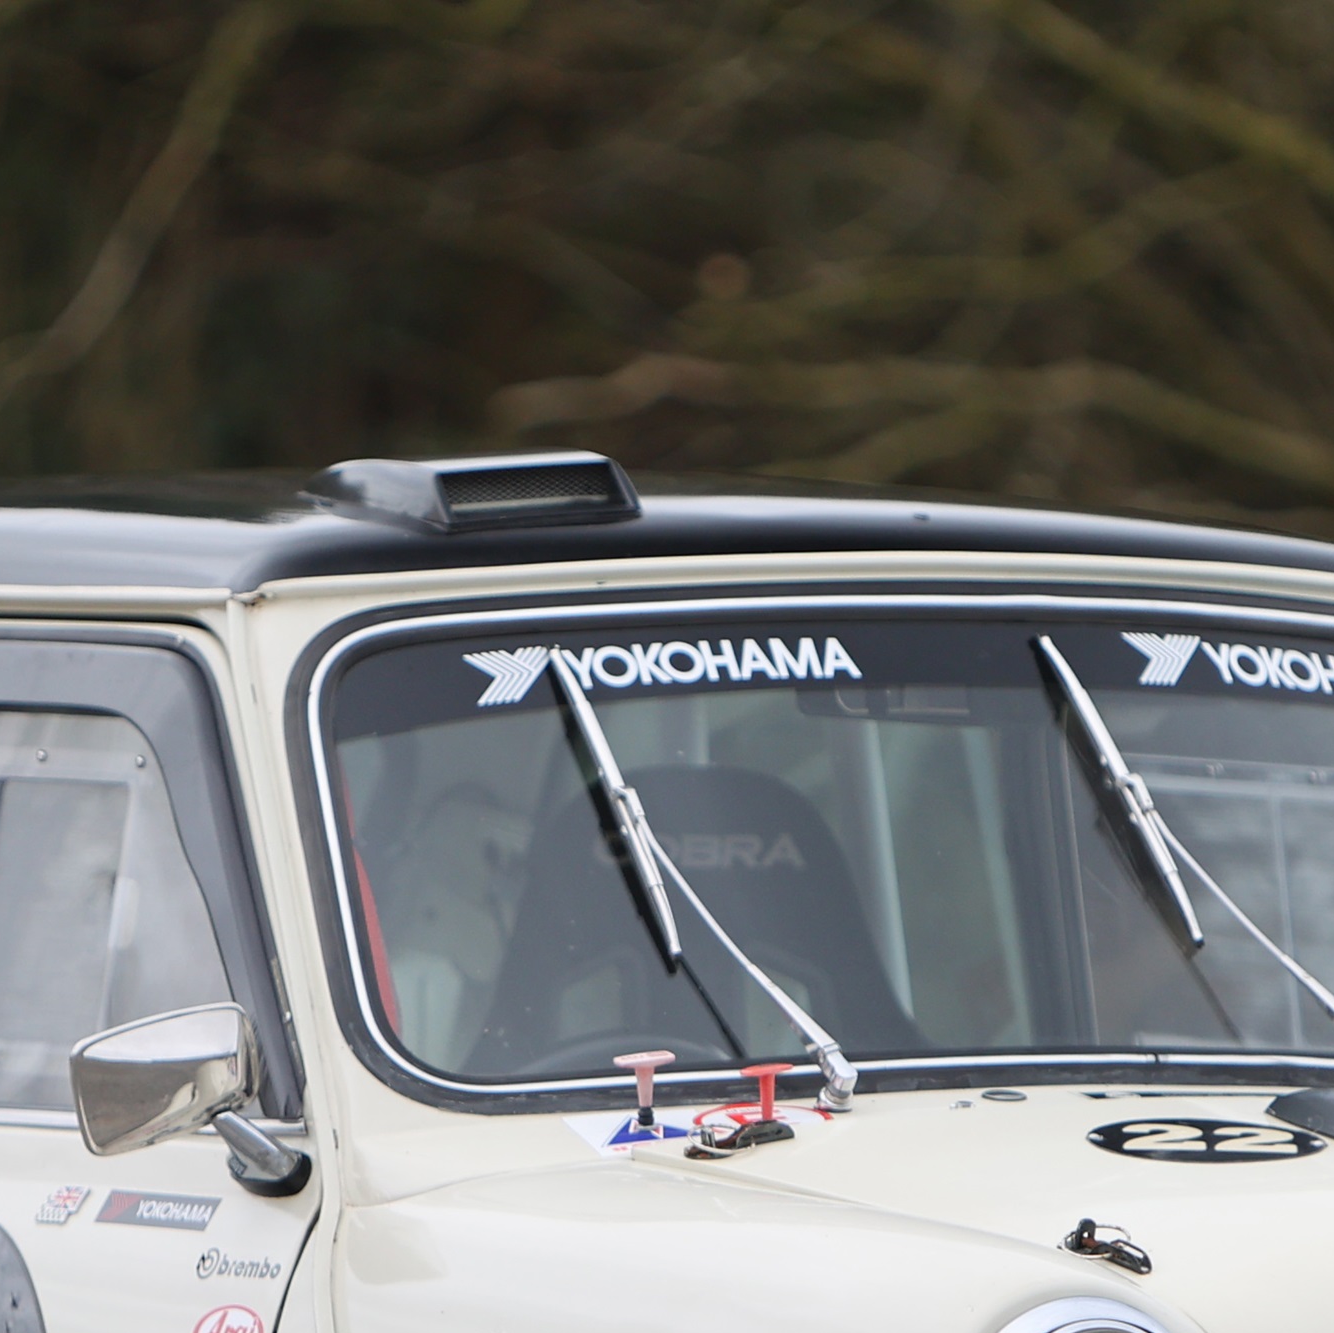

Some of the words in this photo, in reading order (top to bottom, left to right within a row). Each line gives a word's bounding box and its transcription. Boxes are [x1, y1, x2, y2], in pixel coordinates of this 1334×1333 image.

[563, 637, 863, 690] YOKOHAMA
[1122, 1122, 1298, 1154] 22
[135, 1199, 214, 1223] YOKOHAMA
[217, 1254, 282, 1279] brembo
